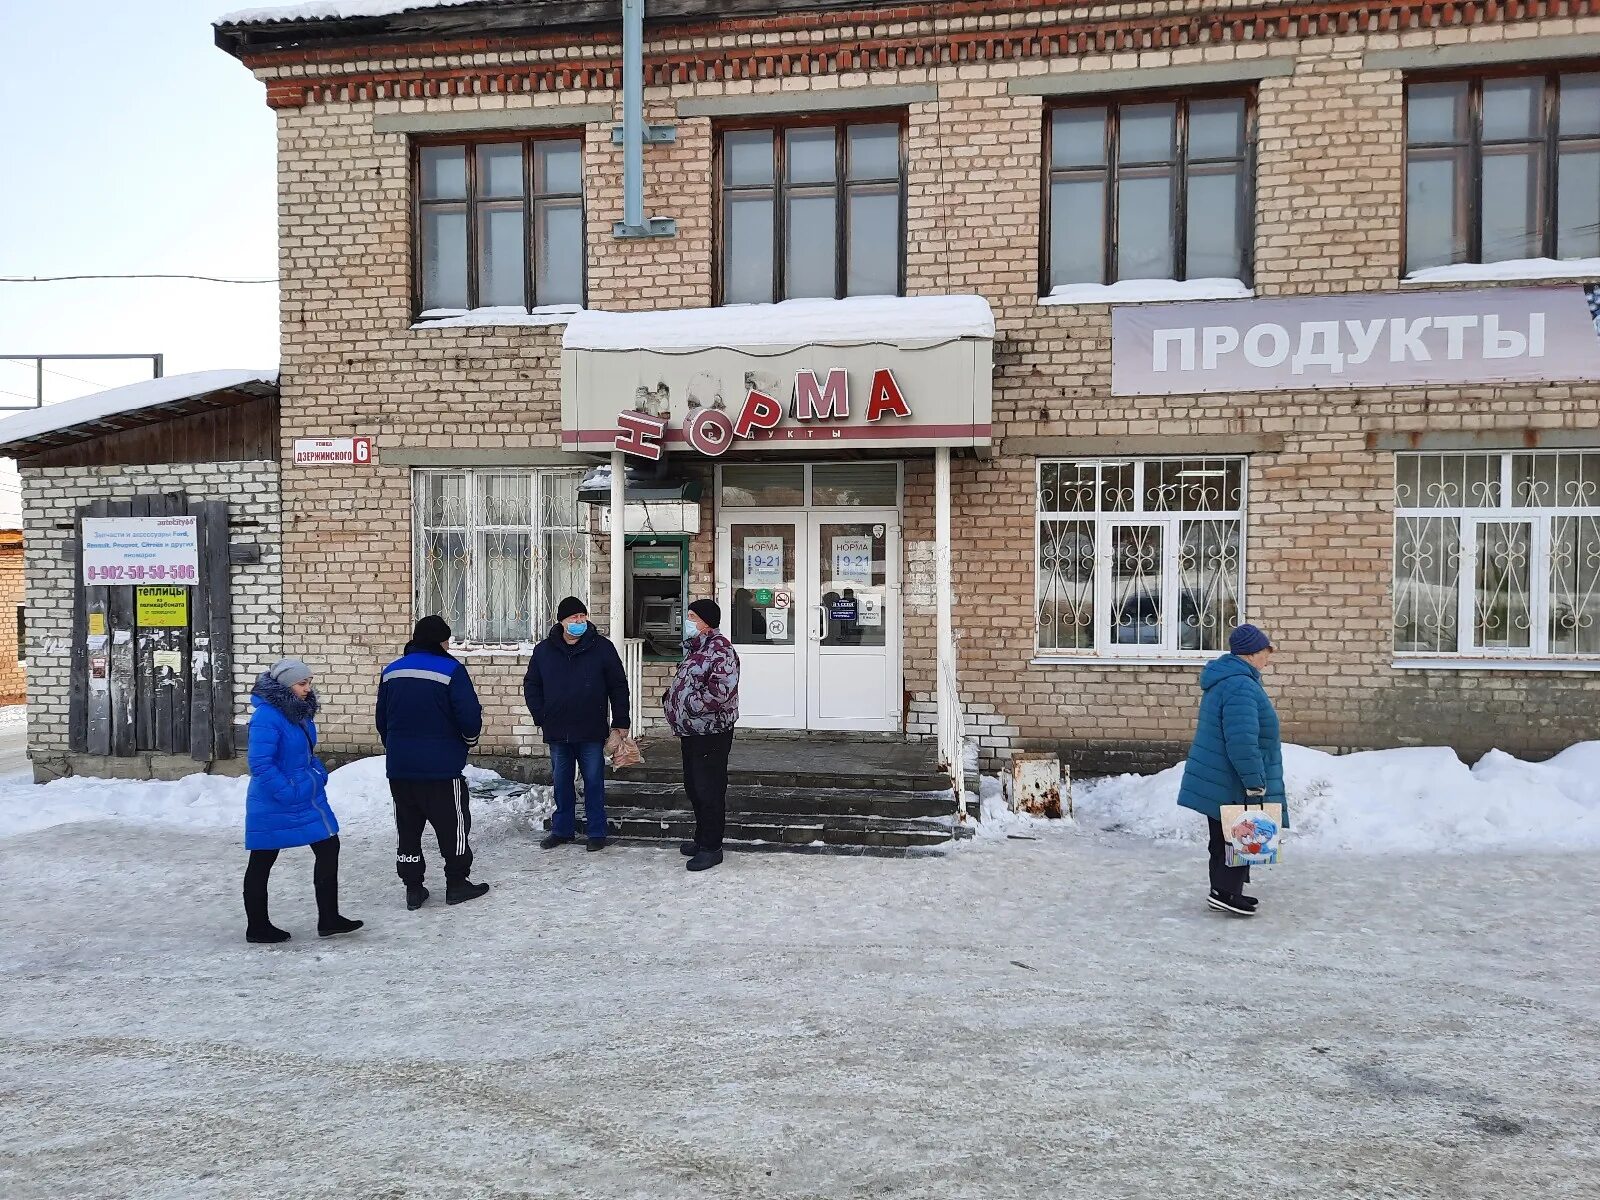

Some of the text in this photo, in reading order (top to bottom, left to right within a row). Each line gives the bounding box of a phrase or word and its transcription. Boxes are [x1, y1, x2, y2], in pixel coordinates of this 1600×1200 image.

[1152, 312, 1546, 375] ПРОДУКТЫ
[614, 367, 912, 461] НОРМА
[297, 451, 352, 462] ДЗЕРЖИНСКОГО
[356, 440, 368, 461] 6
[747, 543, 779, 552] НОРМА
[836, 543, 869, 552] НОРМА
[754, 555, 780, 567] 9-21
[843, 555, 869, 567] 9-21
[138, 587, 184, 597] теплицы
